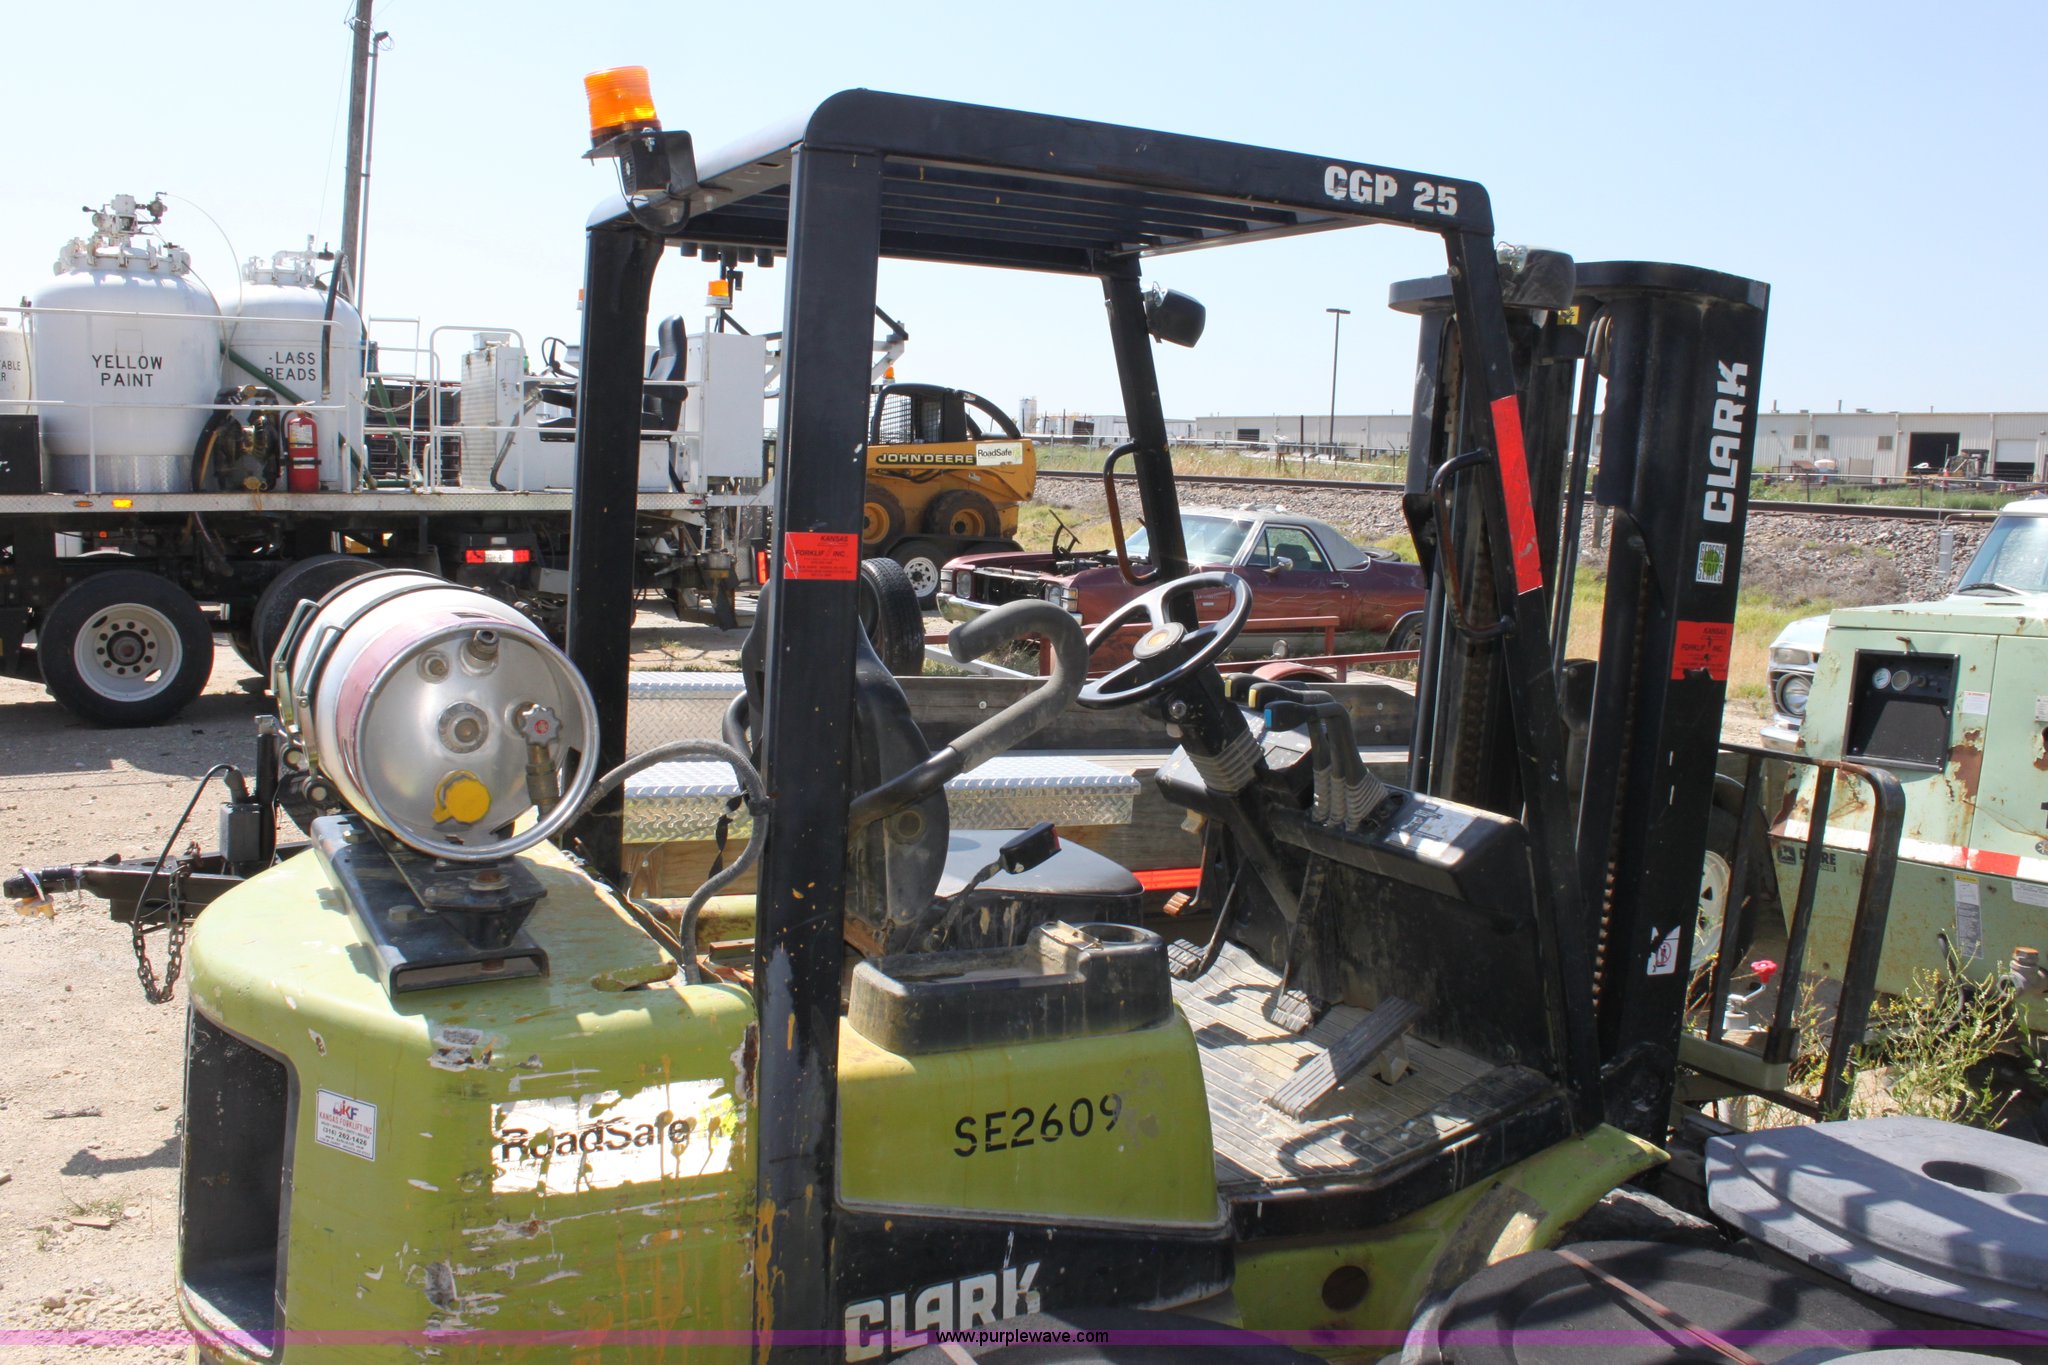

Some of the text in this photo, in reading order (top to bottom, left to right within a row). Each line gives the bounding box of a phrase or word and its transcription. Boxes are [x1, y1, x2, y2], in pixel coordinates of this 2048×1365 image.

[1324, 165, 1458, 217] CGP 25
[92, 355, 163, 370] YELLOW
[268, 351, 316, 365] LASS
[0, 361, 21, 371] ABLE
[101, 373, 153, 387] PAINT
[265, 367, 316, 381] BEADS
[1703, 360, 1748, 523] CLARK
[878, 453, 974, 464] JOHN DEERE
[977, 447, 1012, 457] RoadSafe
[1799, 847, 1837, 866] DRE
[319, 1111, 339, 1124] KANSAS
[953, 1093, 1123, 1158] SE2609
[844, 1261, 1041, 1364] CLARK
